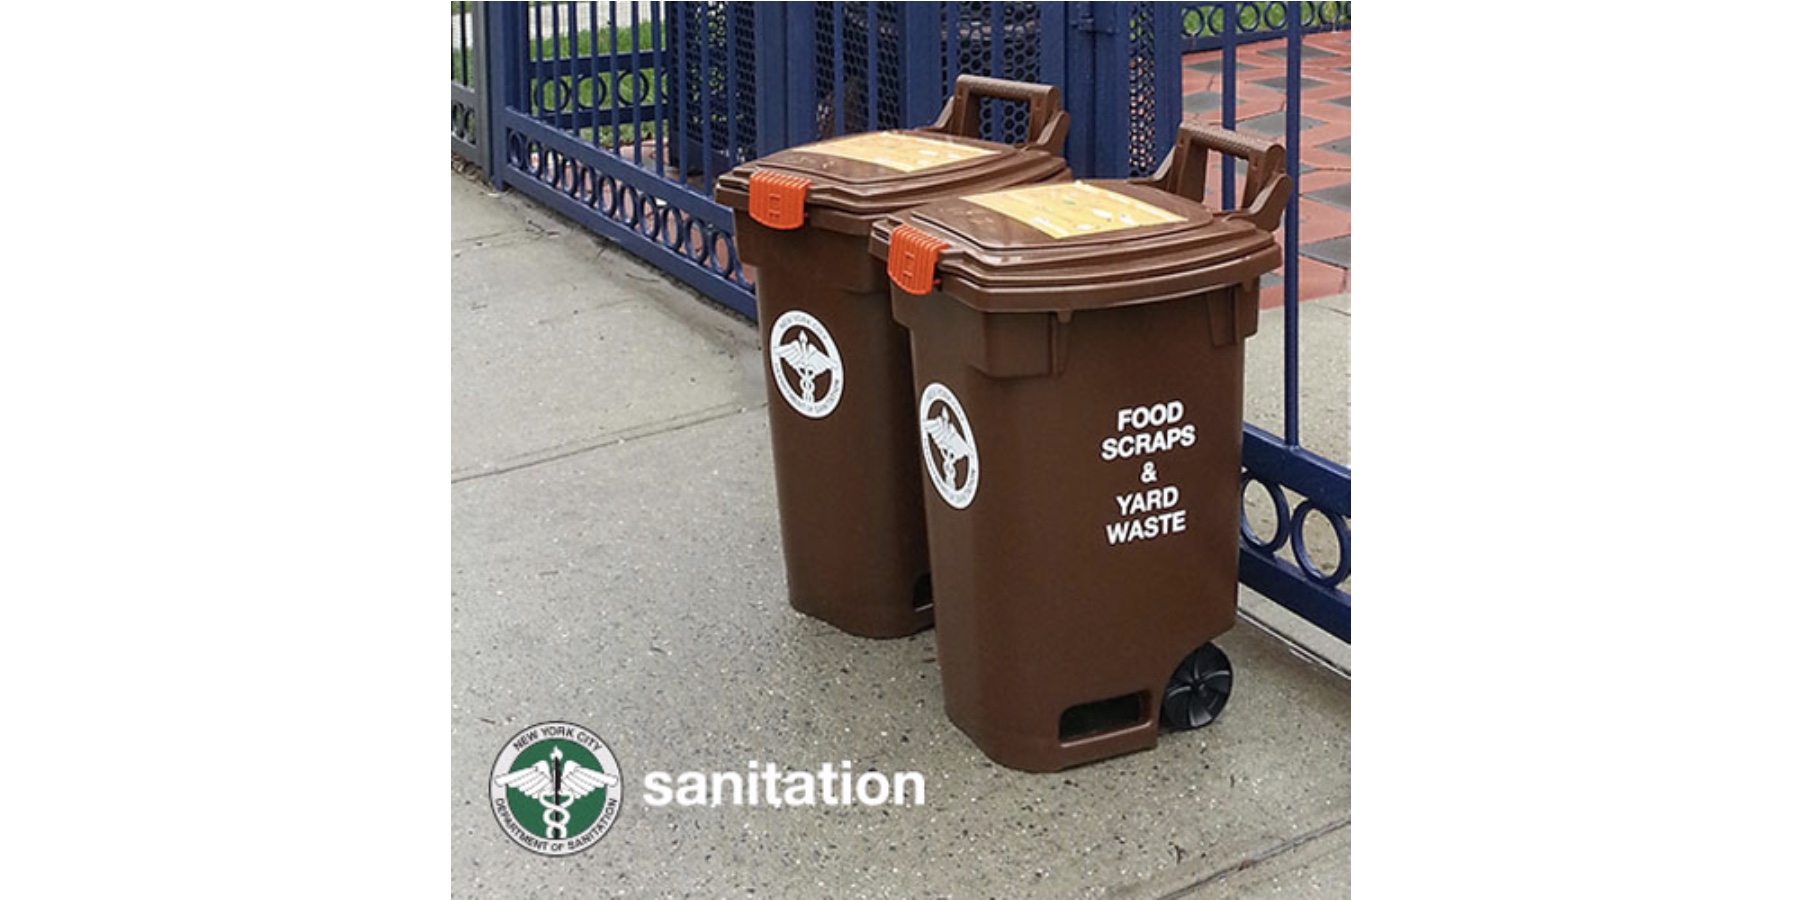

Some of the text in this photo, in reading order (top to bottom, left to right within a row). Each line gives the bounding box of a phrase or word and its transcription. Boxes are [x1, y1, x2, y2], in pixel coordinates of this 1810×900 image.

[1117, 401, 1184, 432] FOOD
[1101, 424, 1196, 460] SCRAPS
[1140, 461, 1158, 483] &
[1116, 486, 1179, 516] YARD
[1106, 510, 1187, 545] WASTE
